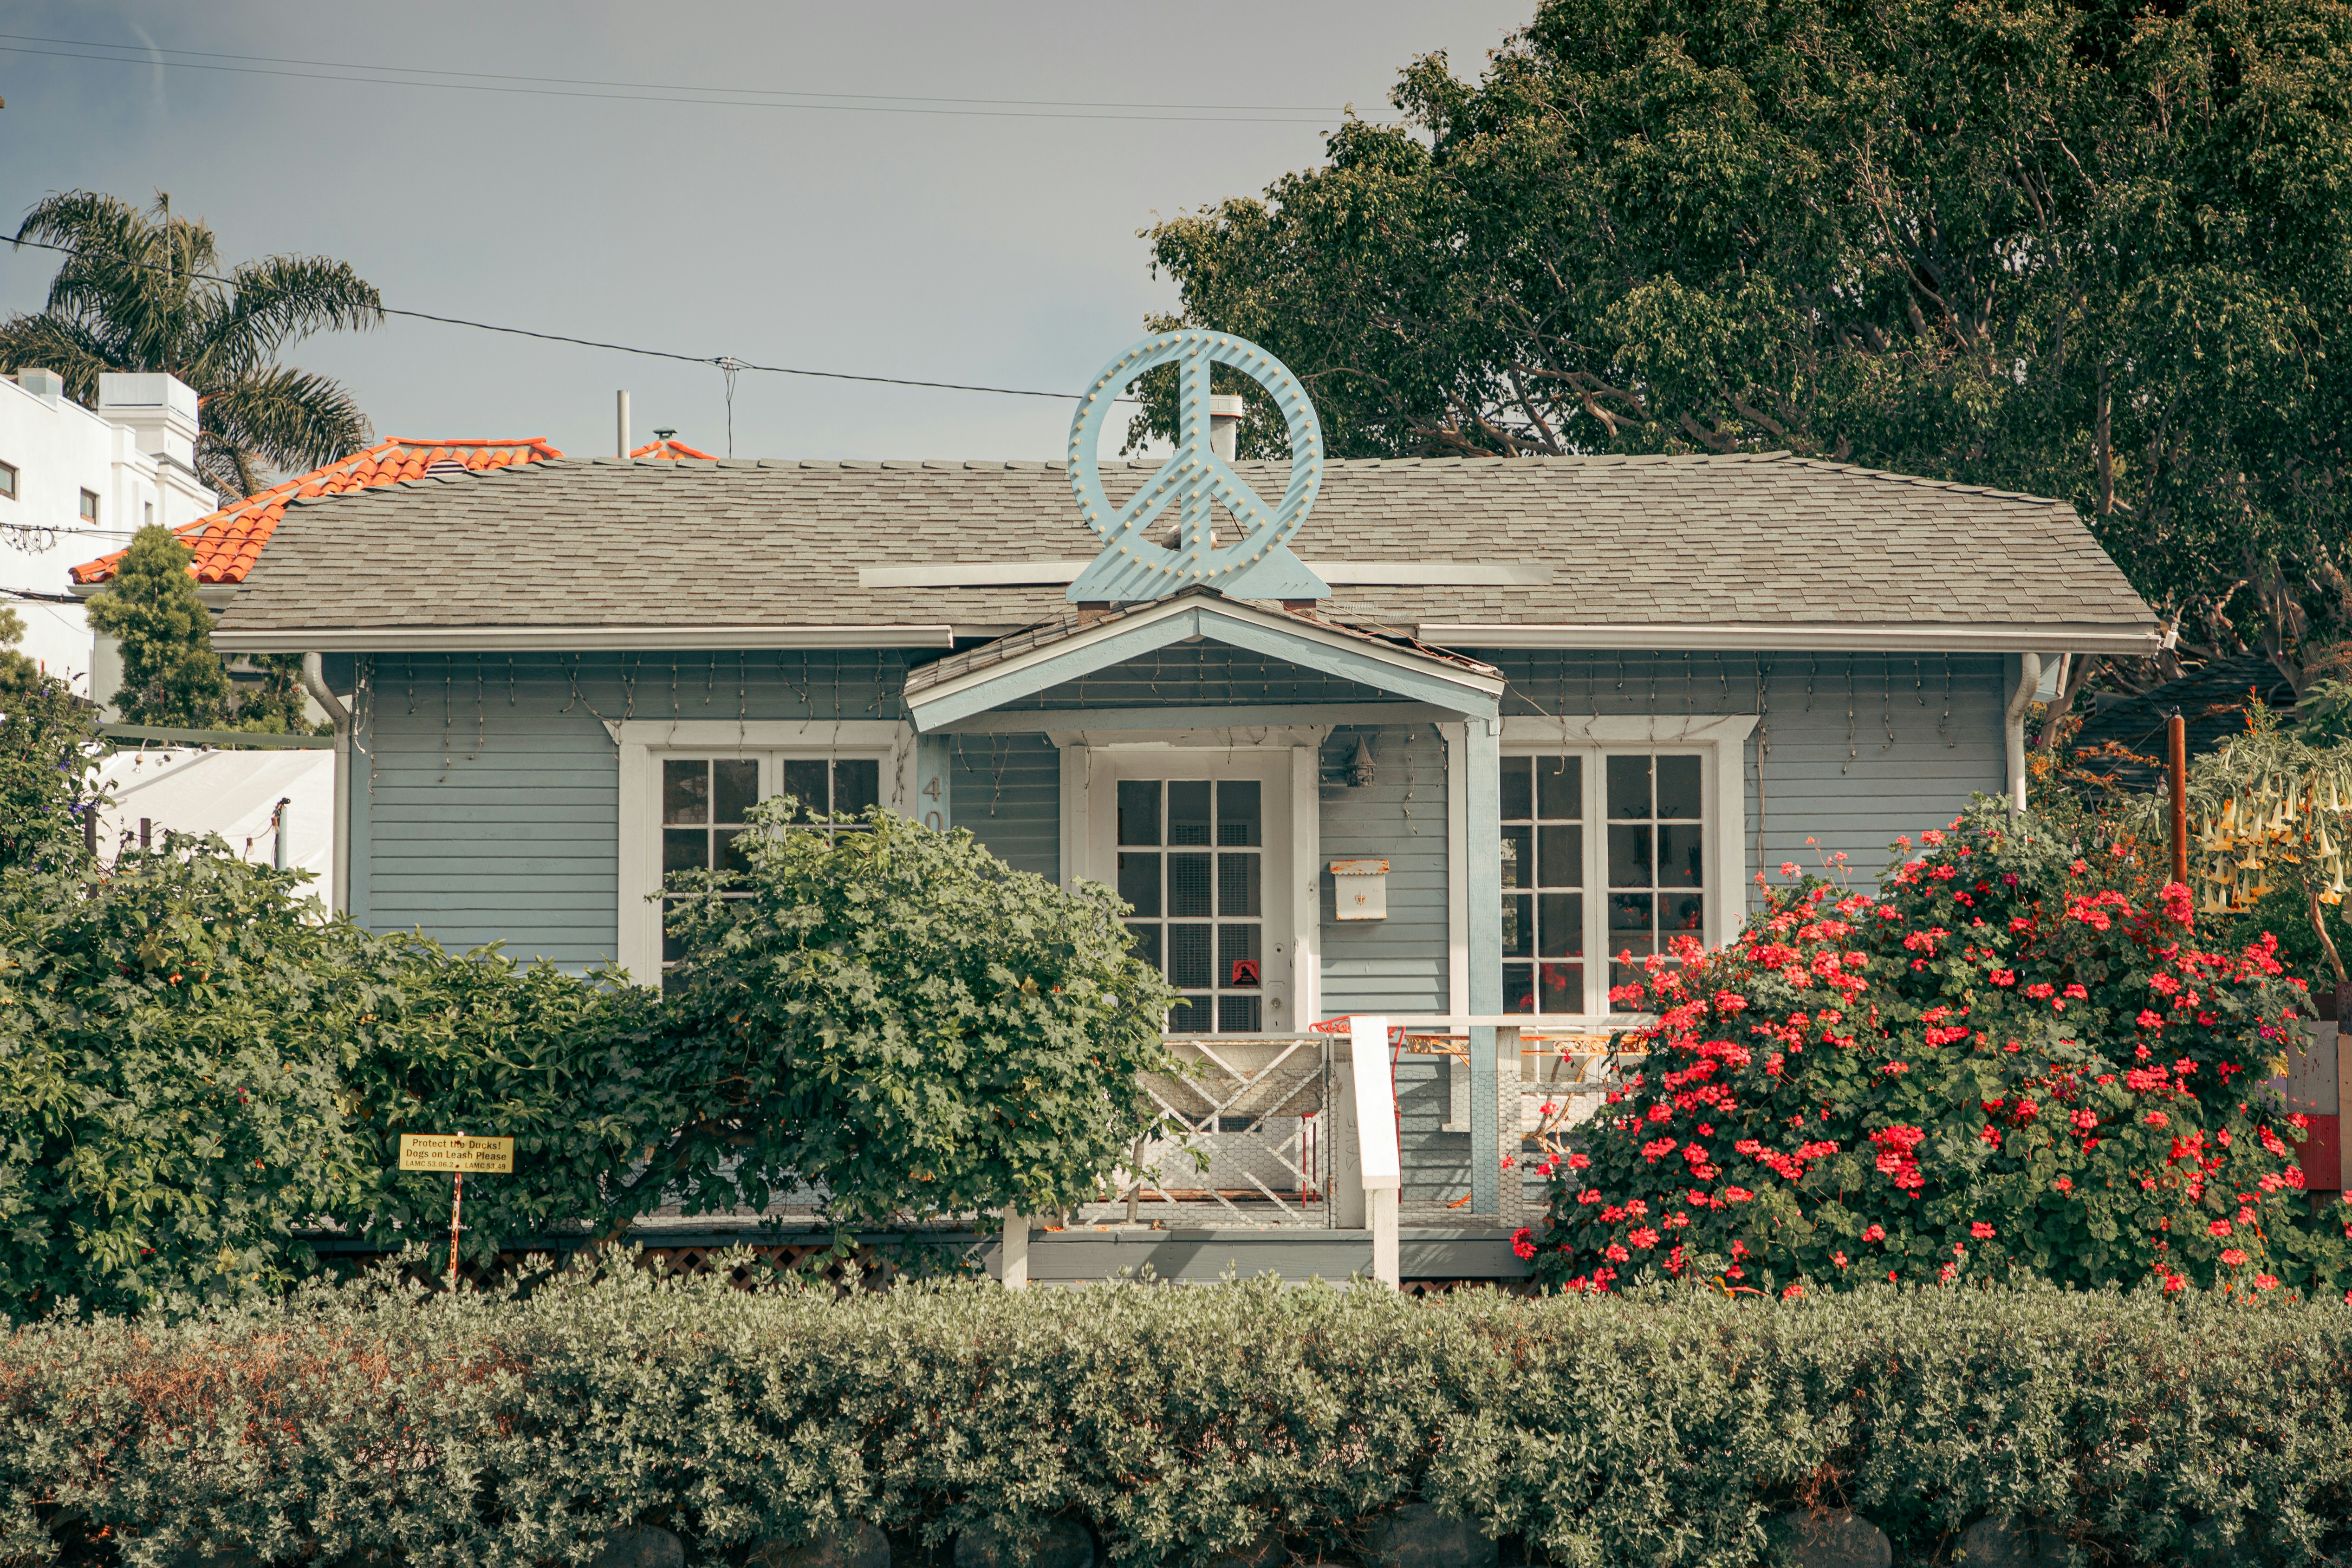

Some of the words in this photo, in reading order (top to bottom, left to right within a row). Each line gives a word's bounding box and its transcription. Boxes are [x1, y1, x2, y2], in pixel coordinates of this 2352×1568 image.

[412, 1139, 447, 1147] Protect
[450, 1140, 465, 1148] the
[469, 1140, 501, 1150] Ducks!
[406, 1149, 429, 1159] Dogs
[446, 1150, 473, 1159] Leash
[476, 1152, 507, 1160] Please
